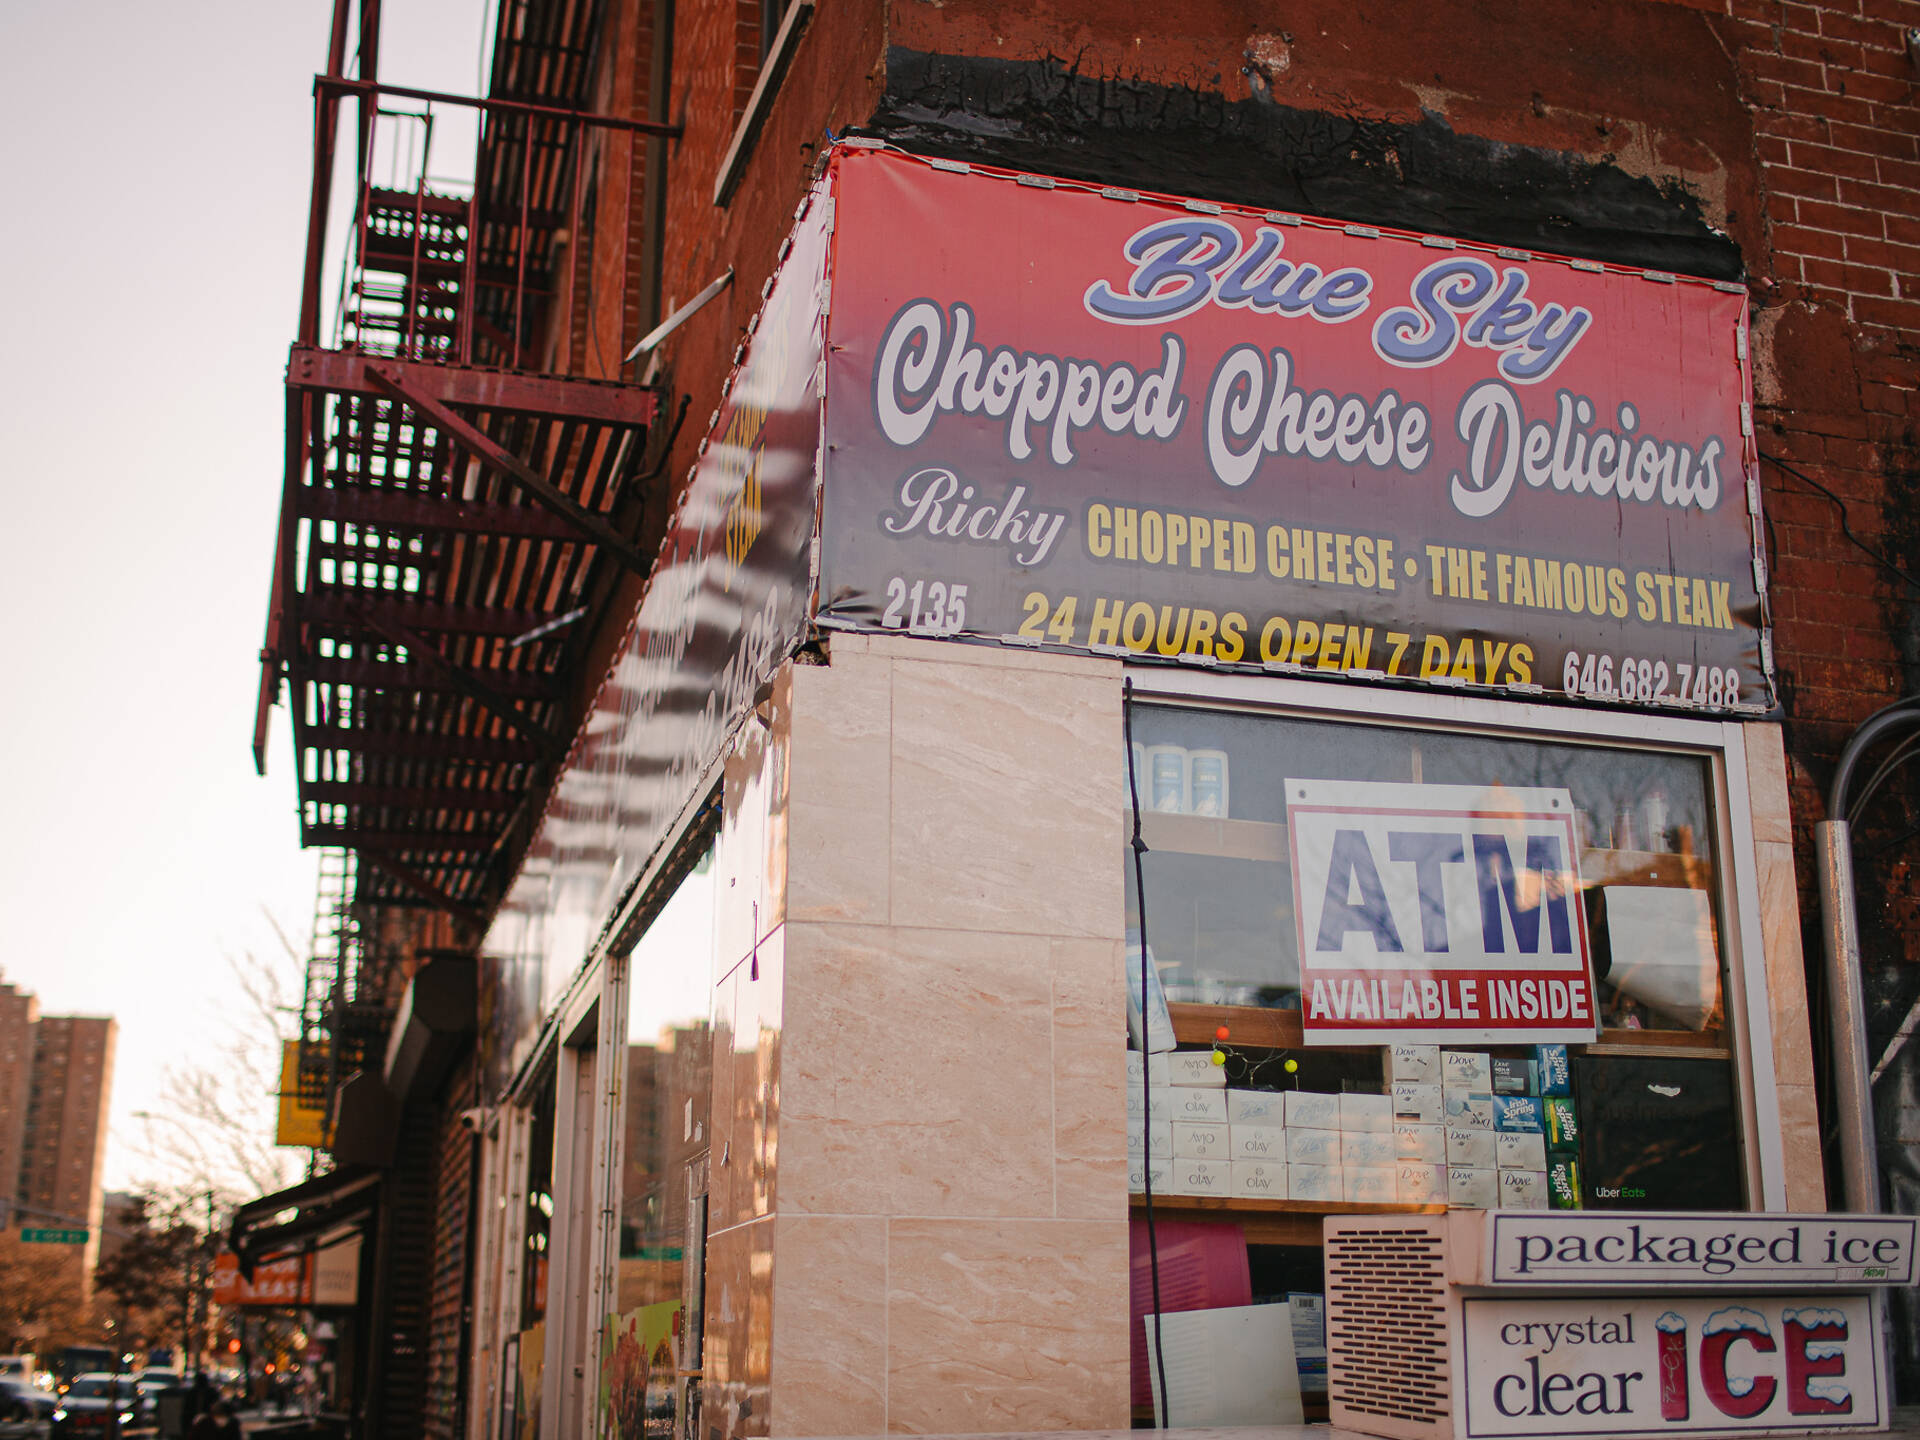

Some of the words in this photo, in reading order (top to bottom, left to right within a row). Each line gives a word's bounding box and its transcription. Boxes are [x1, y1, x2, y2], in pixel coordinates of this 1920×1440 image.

[1084, 217, 1373, 325] Blue
[1372, 257, 1593, 385] Sky
[874, 300, 1186, 466] Chopped
[1206, 346, 1430, 488] Cheese
[1450, 382, 1722, 517] Delicious
[884, 468, 1065, 566] Ricky
[1088, 504, 1256, 574] CHOPPED
[1266, 526, 1396, 591] CHEESE
[1426, 545, 1489, 601] THE
[1496, 554, 1626, 618] FAMOUS
[1636, 571, 1735, 630] STEAK
[881, 577, 968, 634] 2135
[1018, 591, 1078, 645] 24
[1088, 597, 1247, 664] HOURS
[1260, 616, 1375, 675] OPEN
[1386, 632, 1410, 679] 7
[1419, 634, 1534, 688] DAYS
[1563, 651, 1740, 711] 646.682.7488
[1316, 829, 1573, 954] ATM
[1310, 979, 1480, 1020] AVAILABLE
[1487, 979, 1589, 1020] INSIDE
[1395, 1047, 1417, 1057] Dove
[1449, 1054, 1475, 1065] Dove
[1549, 1049, 1565, 1085] Spring
[1558, 1056, 1569, 1078] Irish
[1503, 1103, 1536, 1120] Spring
[1508, 1098, 1529, 1109] Irish
[1450, 1130, 1472, 1140] Dove
[1499, 1133, 1521, 1143] Dove
[1556, 1105, 1573, 1141] Spring
[1565, 1112, 1578, 1135] Irish
[1451, 1171, 1473, 1180] Dove
[1504, 1173, 1532, 1186] Dove
[1551, 1170, 1563, 1193] Irish
[1555, 1163, 1573, 1200] Spring
[1596, 1187, 1621, 1198] Uber
[1621, 1187, 1645, 1198] Eats
[1513, 1226, 1802, 1274] packaged
[1822, 1230, 1900, 1265] ice
[1500, 1313, 1636, 1354] crystal
[1493, 1356, 1644, 1418] clear
[1654, 1306, 1853, 1421] ICE
